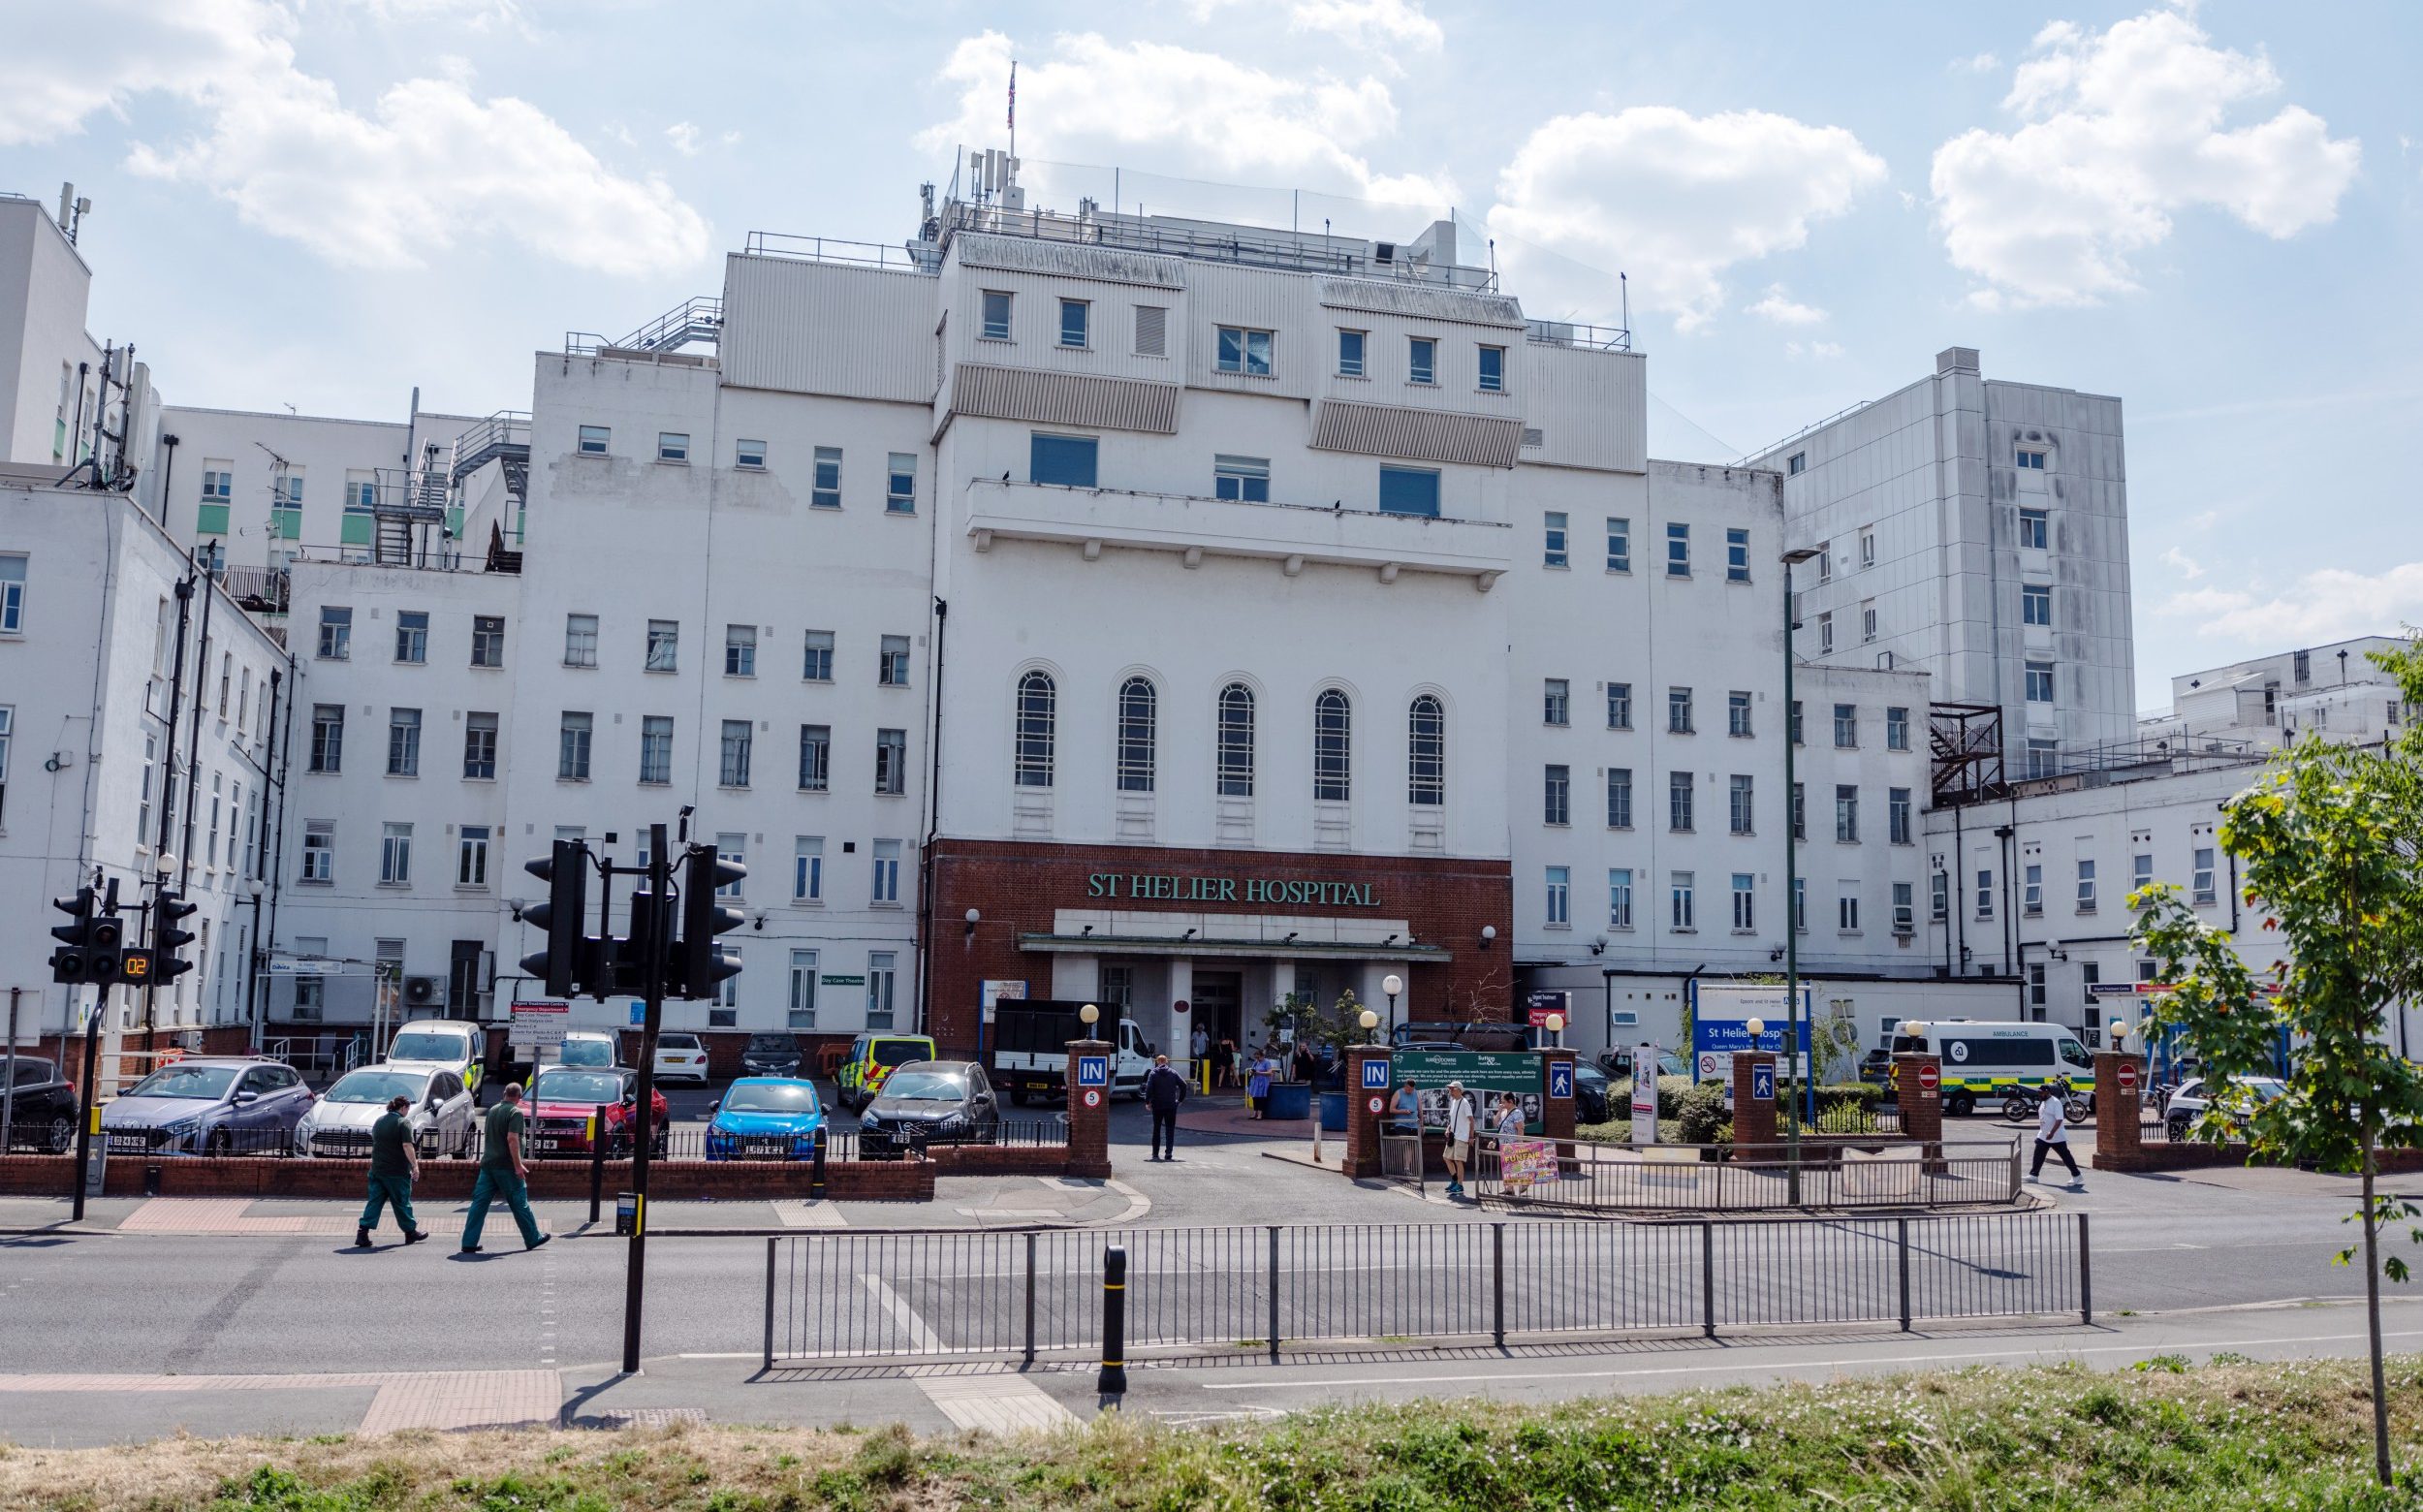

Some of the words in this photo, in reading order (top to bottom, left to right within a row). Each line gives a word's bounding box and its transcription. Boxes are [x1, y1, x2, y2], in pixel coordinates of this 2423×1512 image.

[1087, 873, 1122, 898] ST
[1128, 874, 1238, 901] HELIER
[1245, 879, 1381, 906] HOSPITAL
[127, 959, 146, 974] 02
[1709, 1028, 1718, 1038] St
[1083, 1062, 1102, 1080] IN
[1367, 1066, 1385, 1082] IN
[1373, 1099, 1379, 1108] 5
[1504, 1151, 1541, 1163] FUNFAIR
